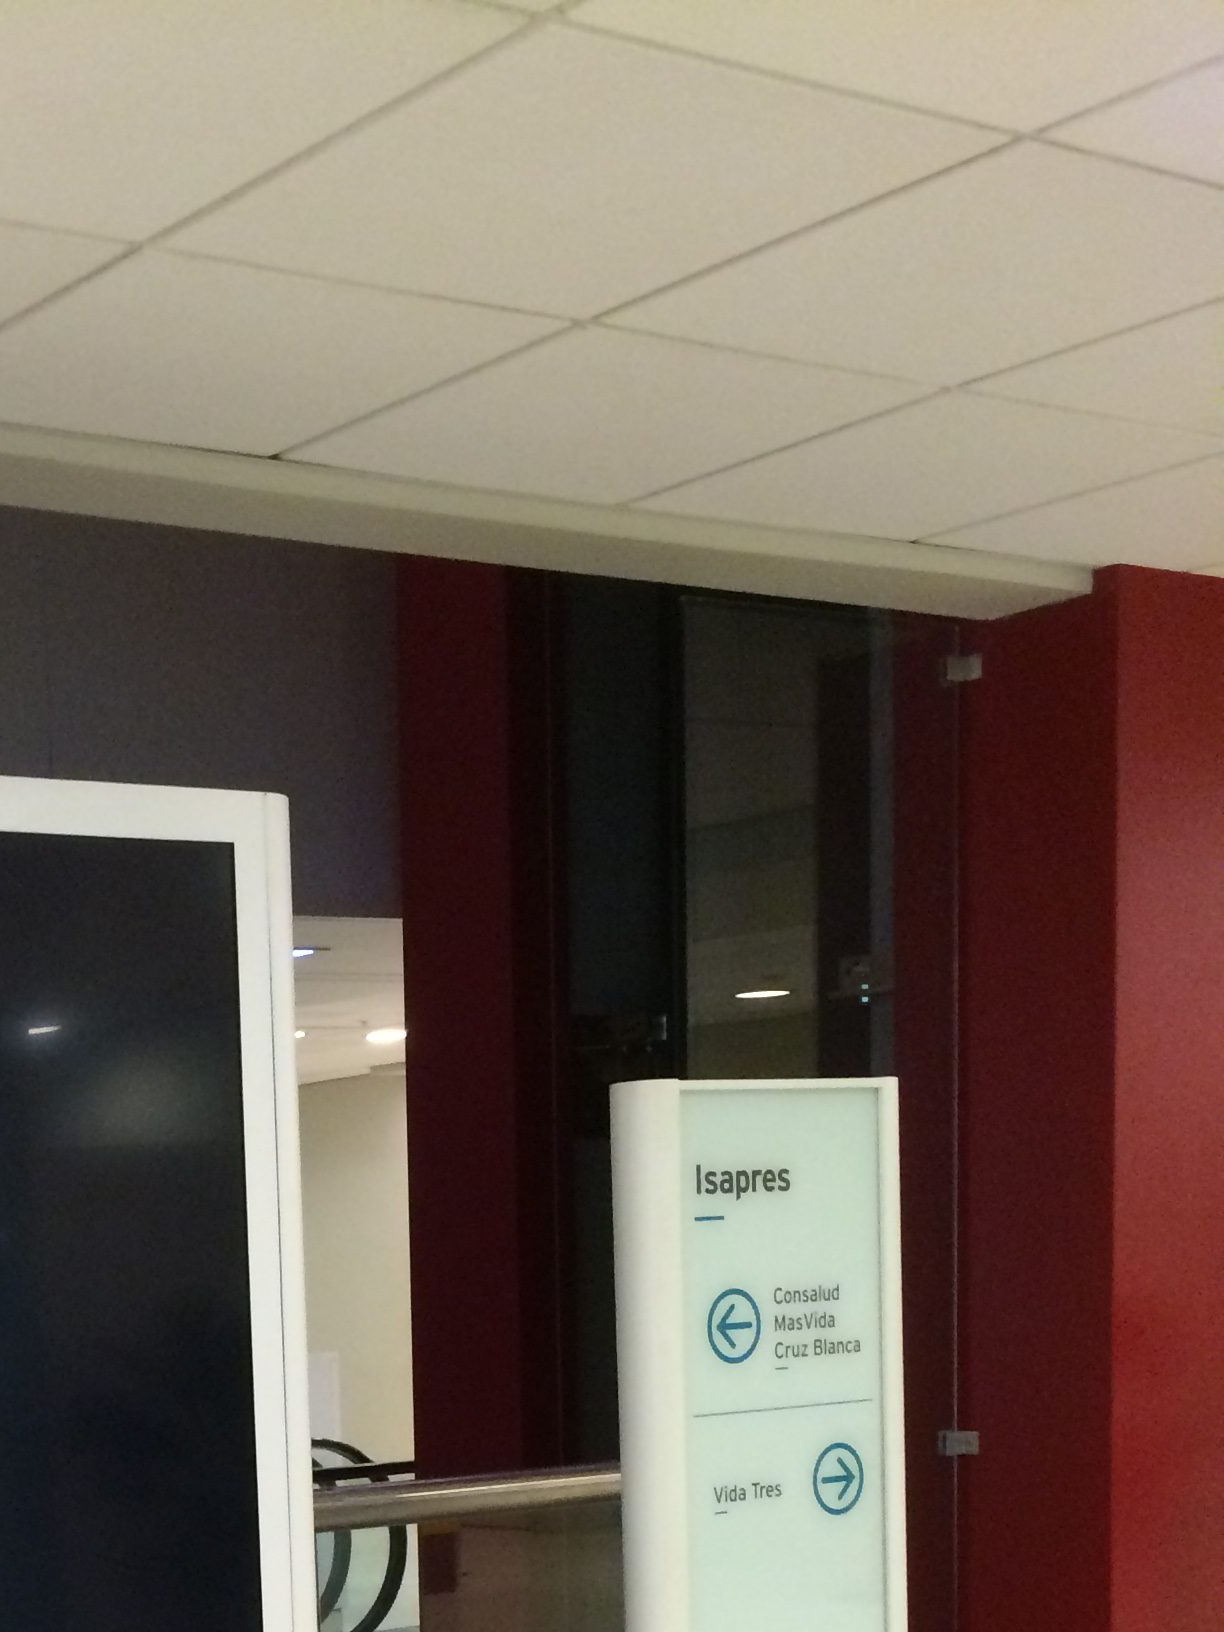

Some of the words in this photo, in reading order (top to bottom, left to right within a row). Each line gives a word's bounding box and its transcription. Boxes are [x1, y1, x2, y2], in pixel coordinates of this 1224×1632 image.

[695, 1164, 791, 1201] Isapres
[773, 1283, 840, 1305] Consalud
[774, 1311, 836, 1332] MasVida
[774, 1341, 809, 1359] Cruz
[813, 1338, 861, 1356] Blanca
[713, 1484, 747, 1504] Vida
[751, 1482, 783, 1499] Tres
